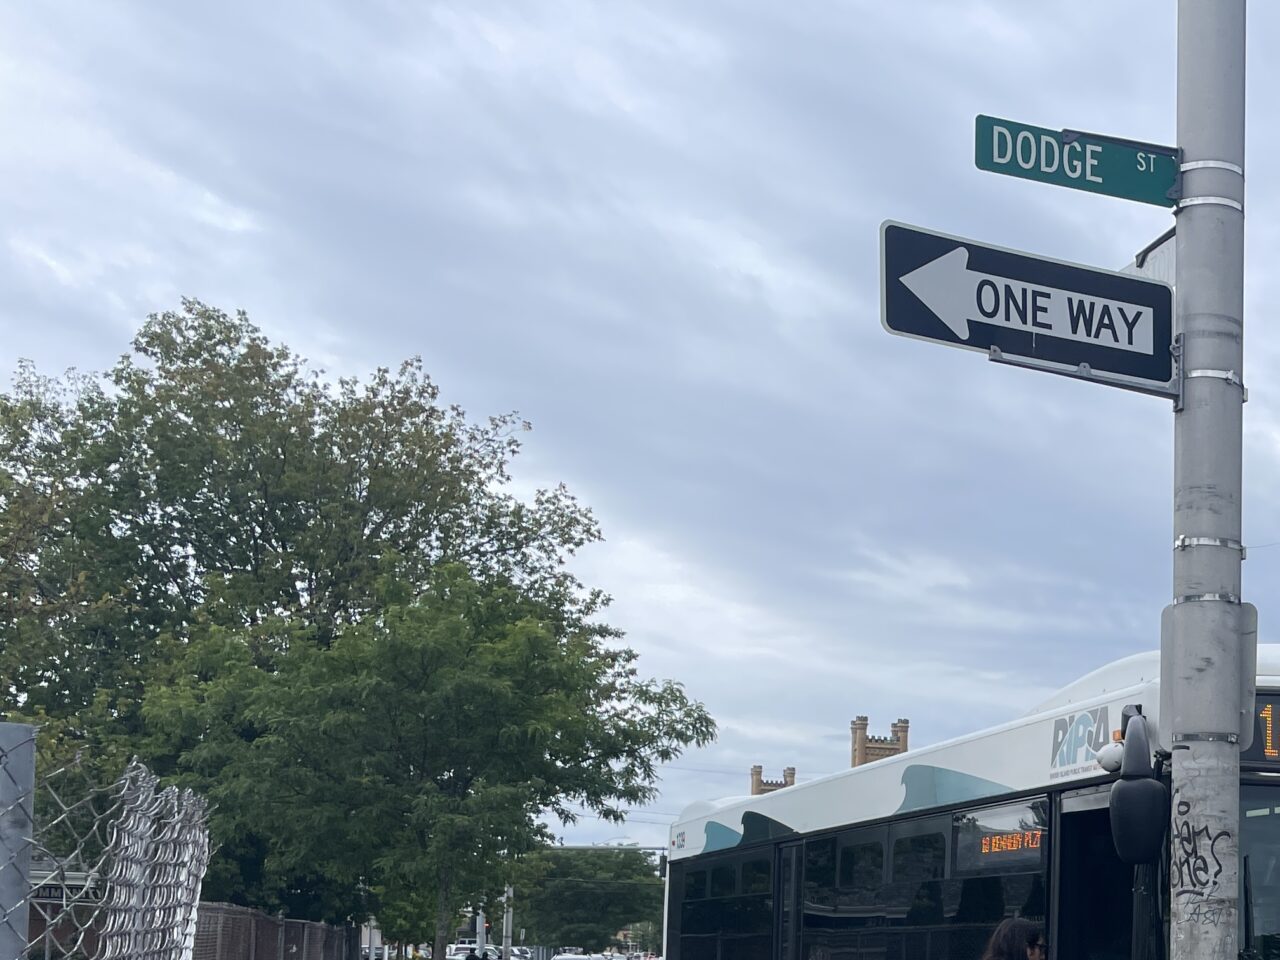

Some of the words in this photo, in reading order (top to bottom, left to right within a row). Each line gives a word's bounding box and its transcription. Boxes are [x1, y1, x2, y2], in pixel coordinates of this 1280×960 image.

[992, 125, 1103, 183] DODGE
[1136, 152, 1156, 173] ST
[975, 278, 1053, 330] ONE
[1066, 296, 1143, 346] WAY
